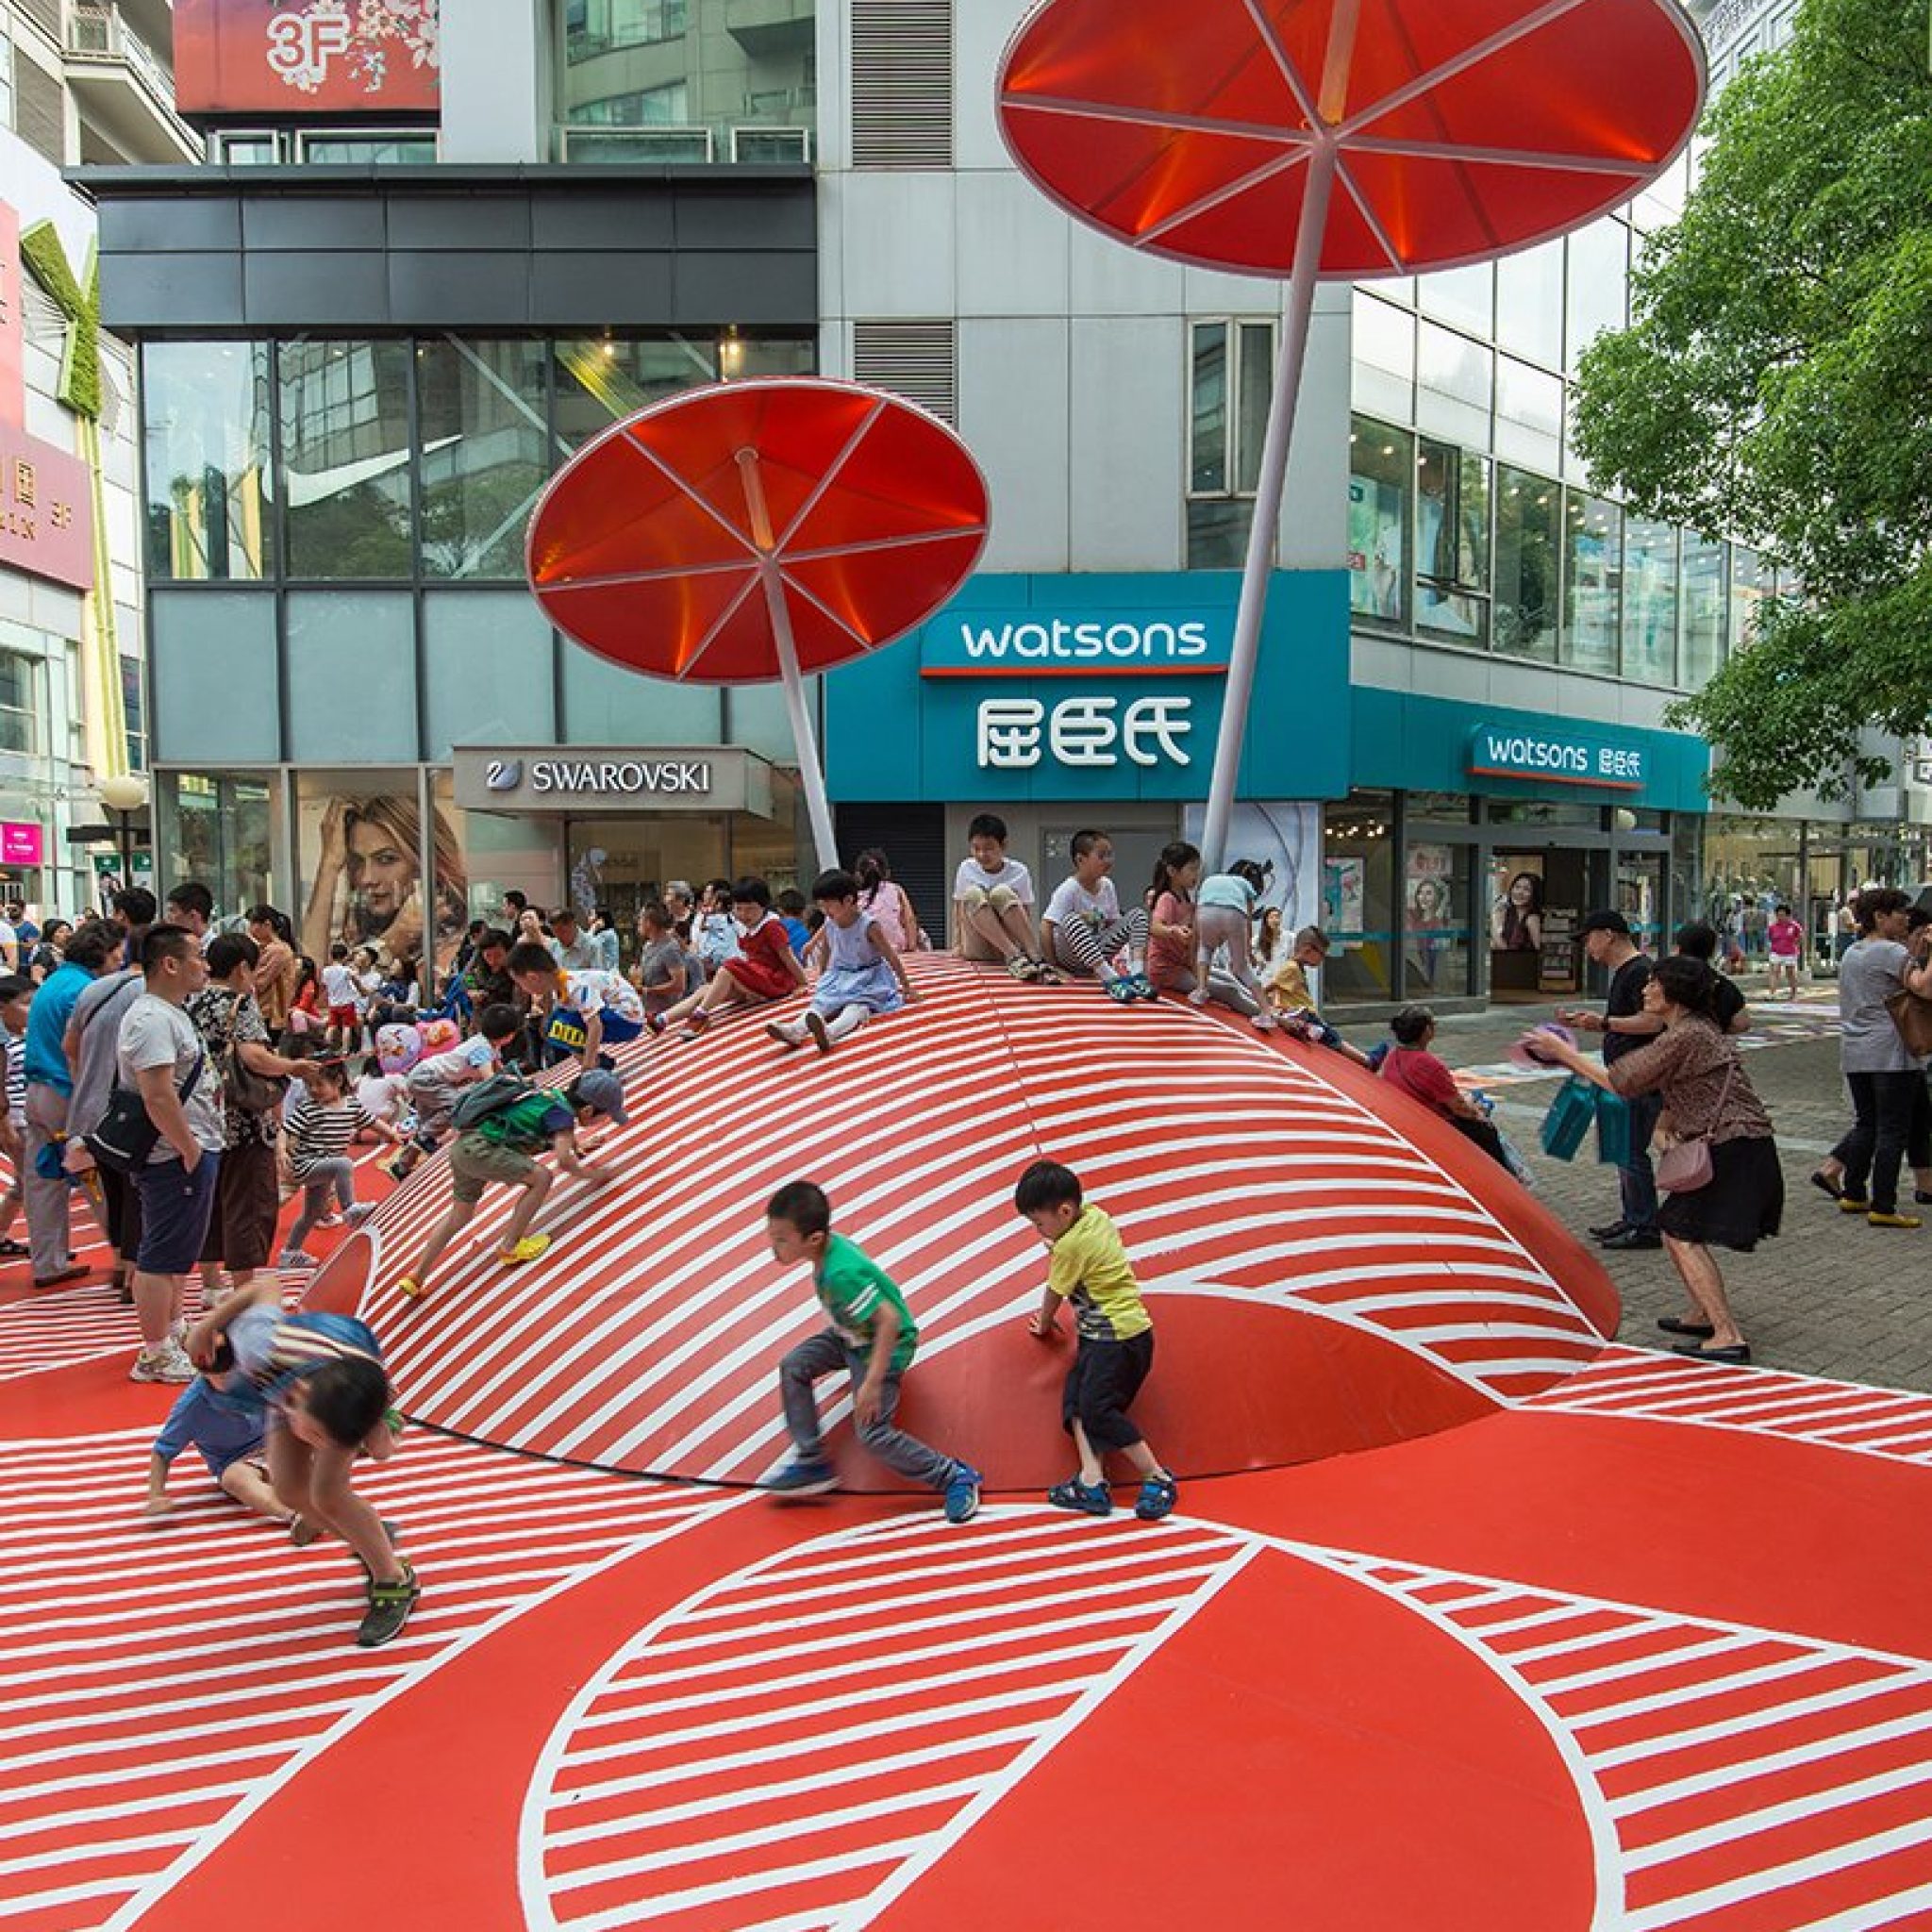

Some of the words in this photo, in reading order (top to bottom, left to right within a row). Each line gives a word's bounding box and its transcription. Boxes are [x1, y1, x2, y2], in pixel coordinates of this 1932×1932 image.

[268, 14, 349, 75] 3F
[960, 619, 1208, 658] watsons
[977, 696, 1192, 768] 屈臣氏
[1487, 736, 1589, 771] watsons
[533, 761, 710, 792] SWAROVSKI
